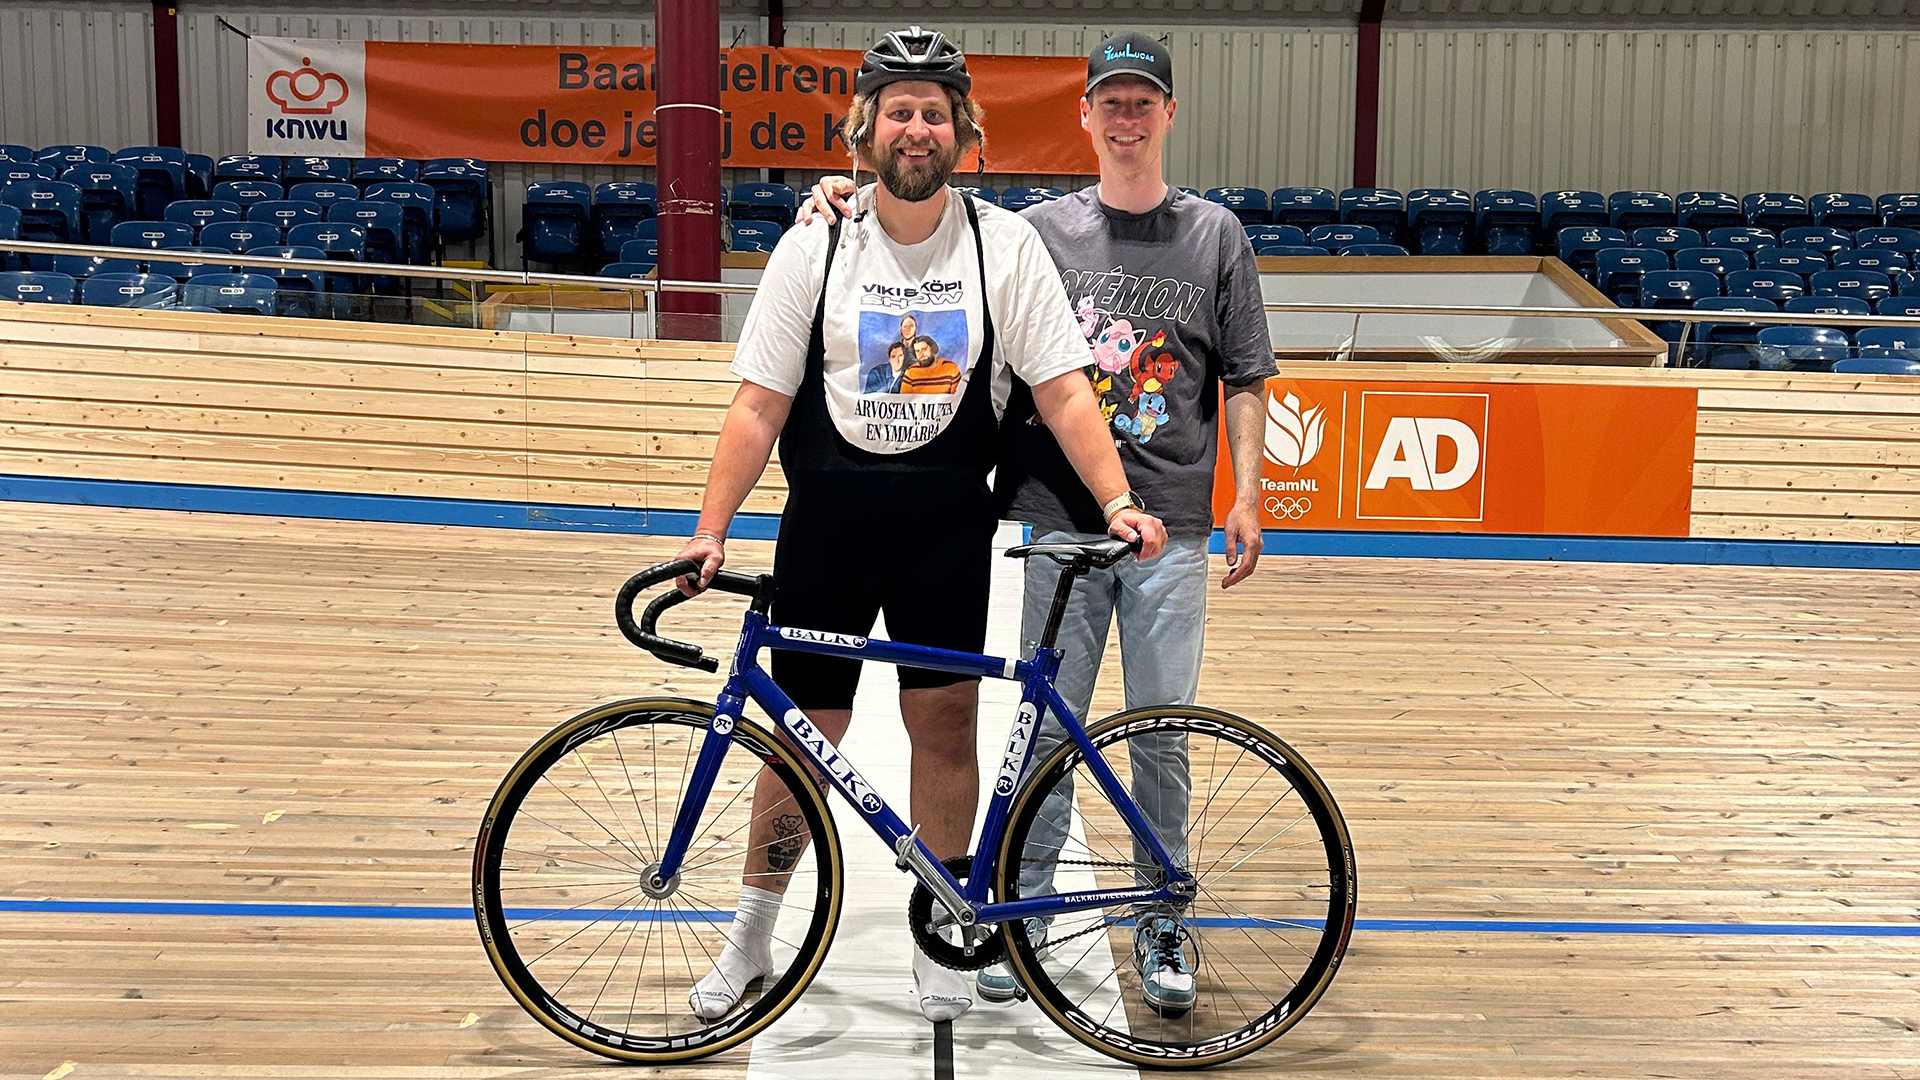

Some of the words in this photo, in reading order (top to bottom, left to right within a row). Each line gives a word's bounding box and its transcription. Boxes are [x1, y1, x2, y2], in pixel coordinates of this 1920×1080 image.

[266, 118, 348, 141] KNWU
[520, 108, 606, 148] doe
[750, 112, 805, 150] de
[860, 291, 964, 309] SHOW
[862, 283, 901, 297] VIKI
[920, 279, 963, 293] KÖPI
[1060, 265, 1206, 325] OKÉMON
[865, 423, 882, 441] EN
[1364, 416, 1480, 491] AD
[1260, 478, 1319, 492] TeamNL
[788, 628, 849, 646] BALK
[792, 716, 870, 796] BALK
[1001, 710, 1033, 772] BALK
[543, 995, 753, 1049] MICHE
